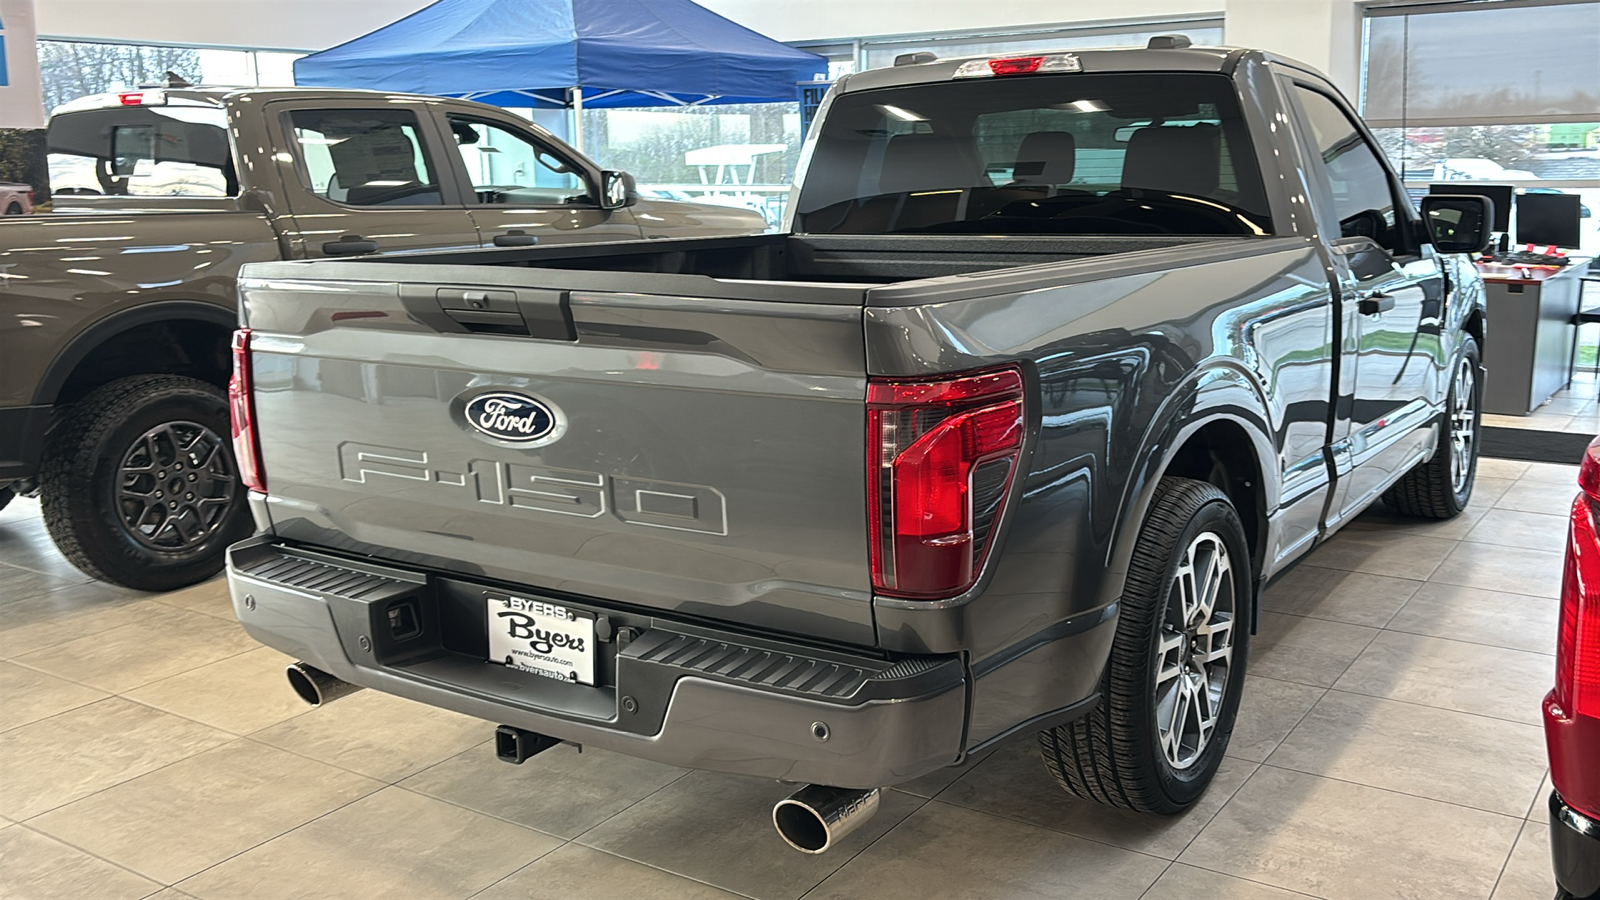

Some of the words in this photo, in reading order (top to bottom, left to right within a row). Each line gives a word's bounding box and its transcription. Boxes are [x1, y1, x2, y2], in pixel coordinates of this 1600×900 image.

[480, 399, 537, 434] Ford
[338, 441, 728, 536] F-150
[510, 597, 567, 619] BYERS
[497, 612, 585, 654] Byers
[511, 649, 574, 667] www.byersauto.com
